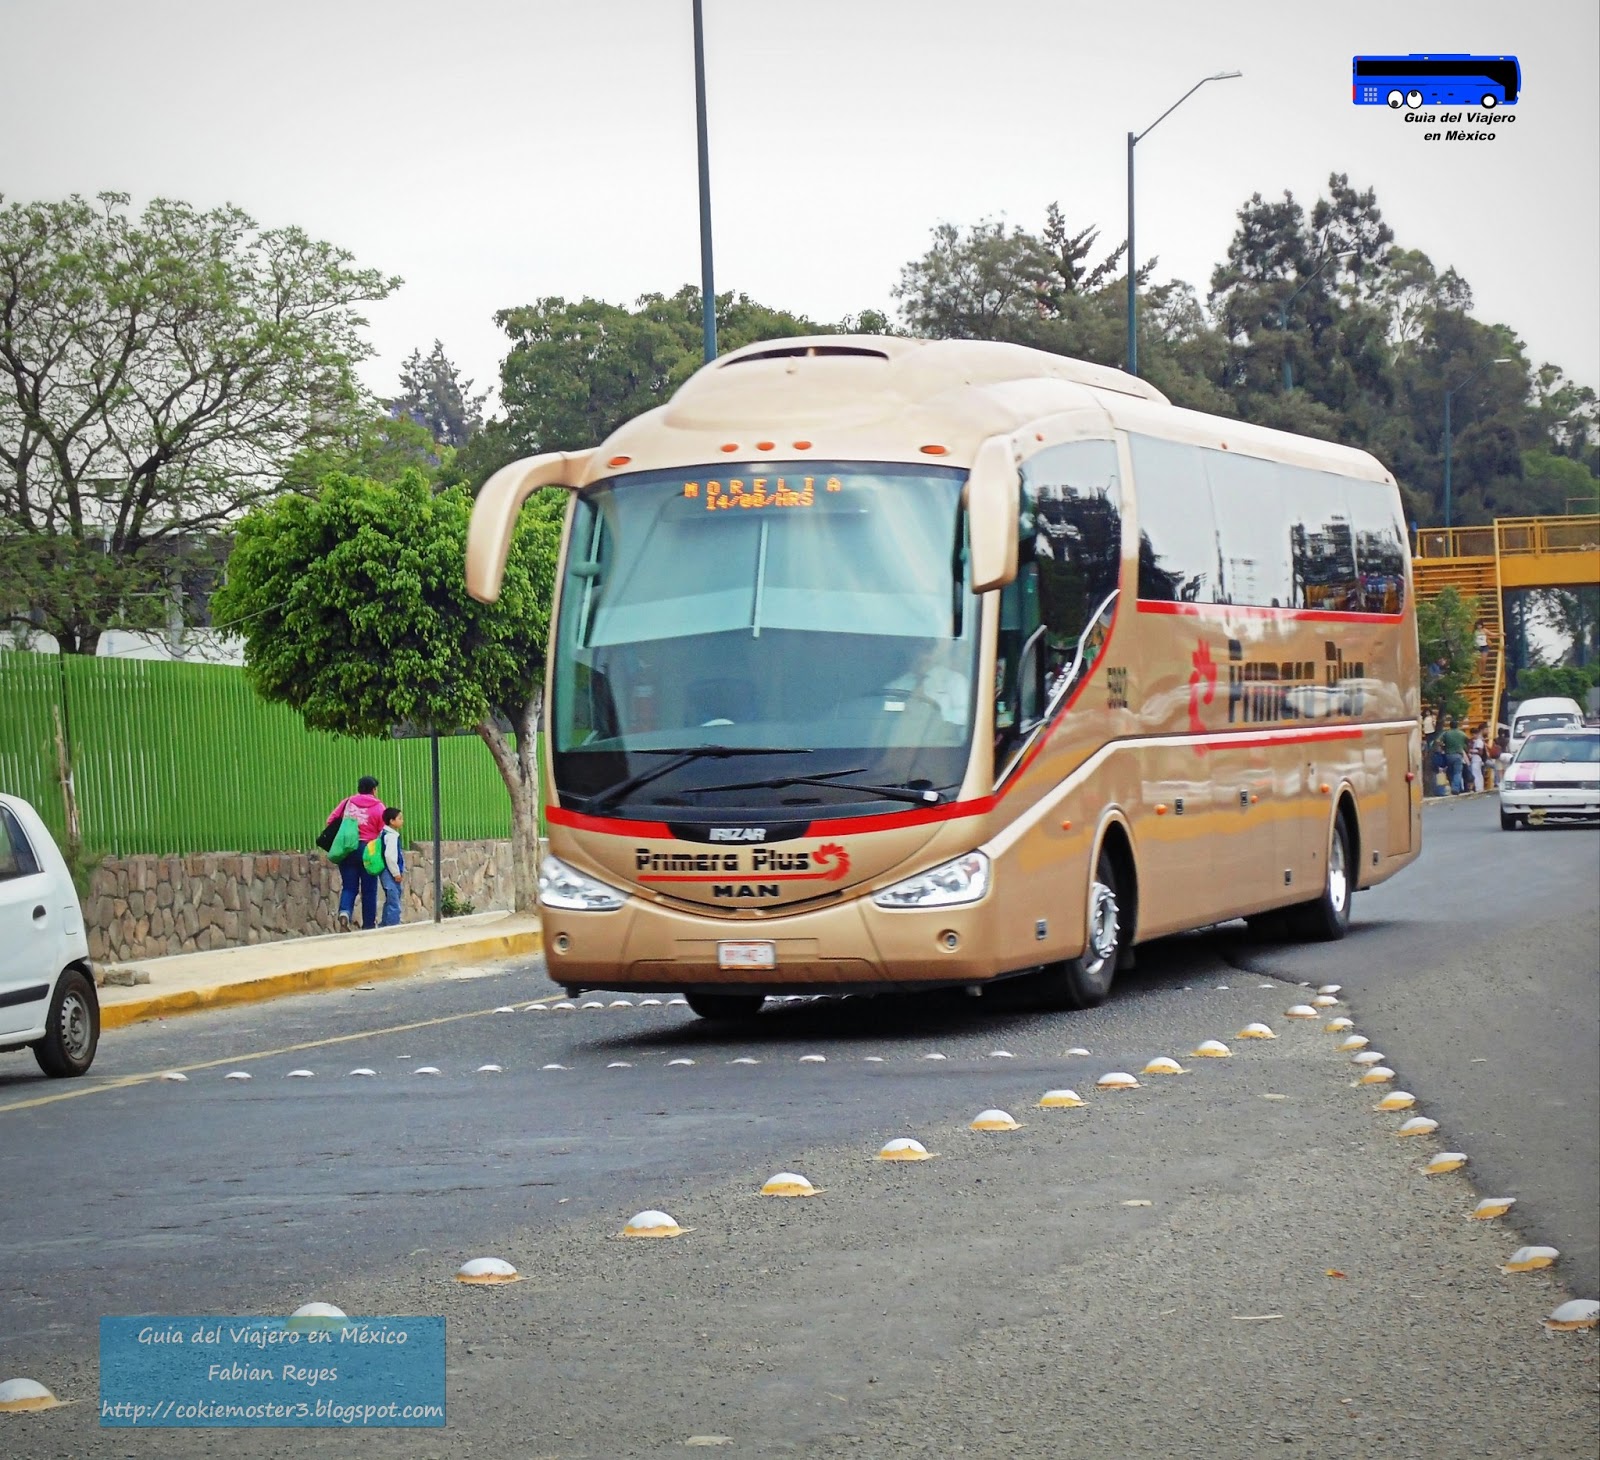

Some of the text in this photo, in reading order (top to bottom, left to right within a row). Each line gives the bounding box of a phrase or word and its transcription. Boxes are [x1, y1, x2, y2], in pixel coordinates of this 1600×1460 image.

[709, 828, 767, 841] IRIZAR
[636, 848, 809, 871] Primera Plus
[713, 884, 779, 897] MAN
